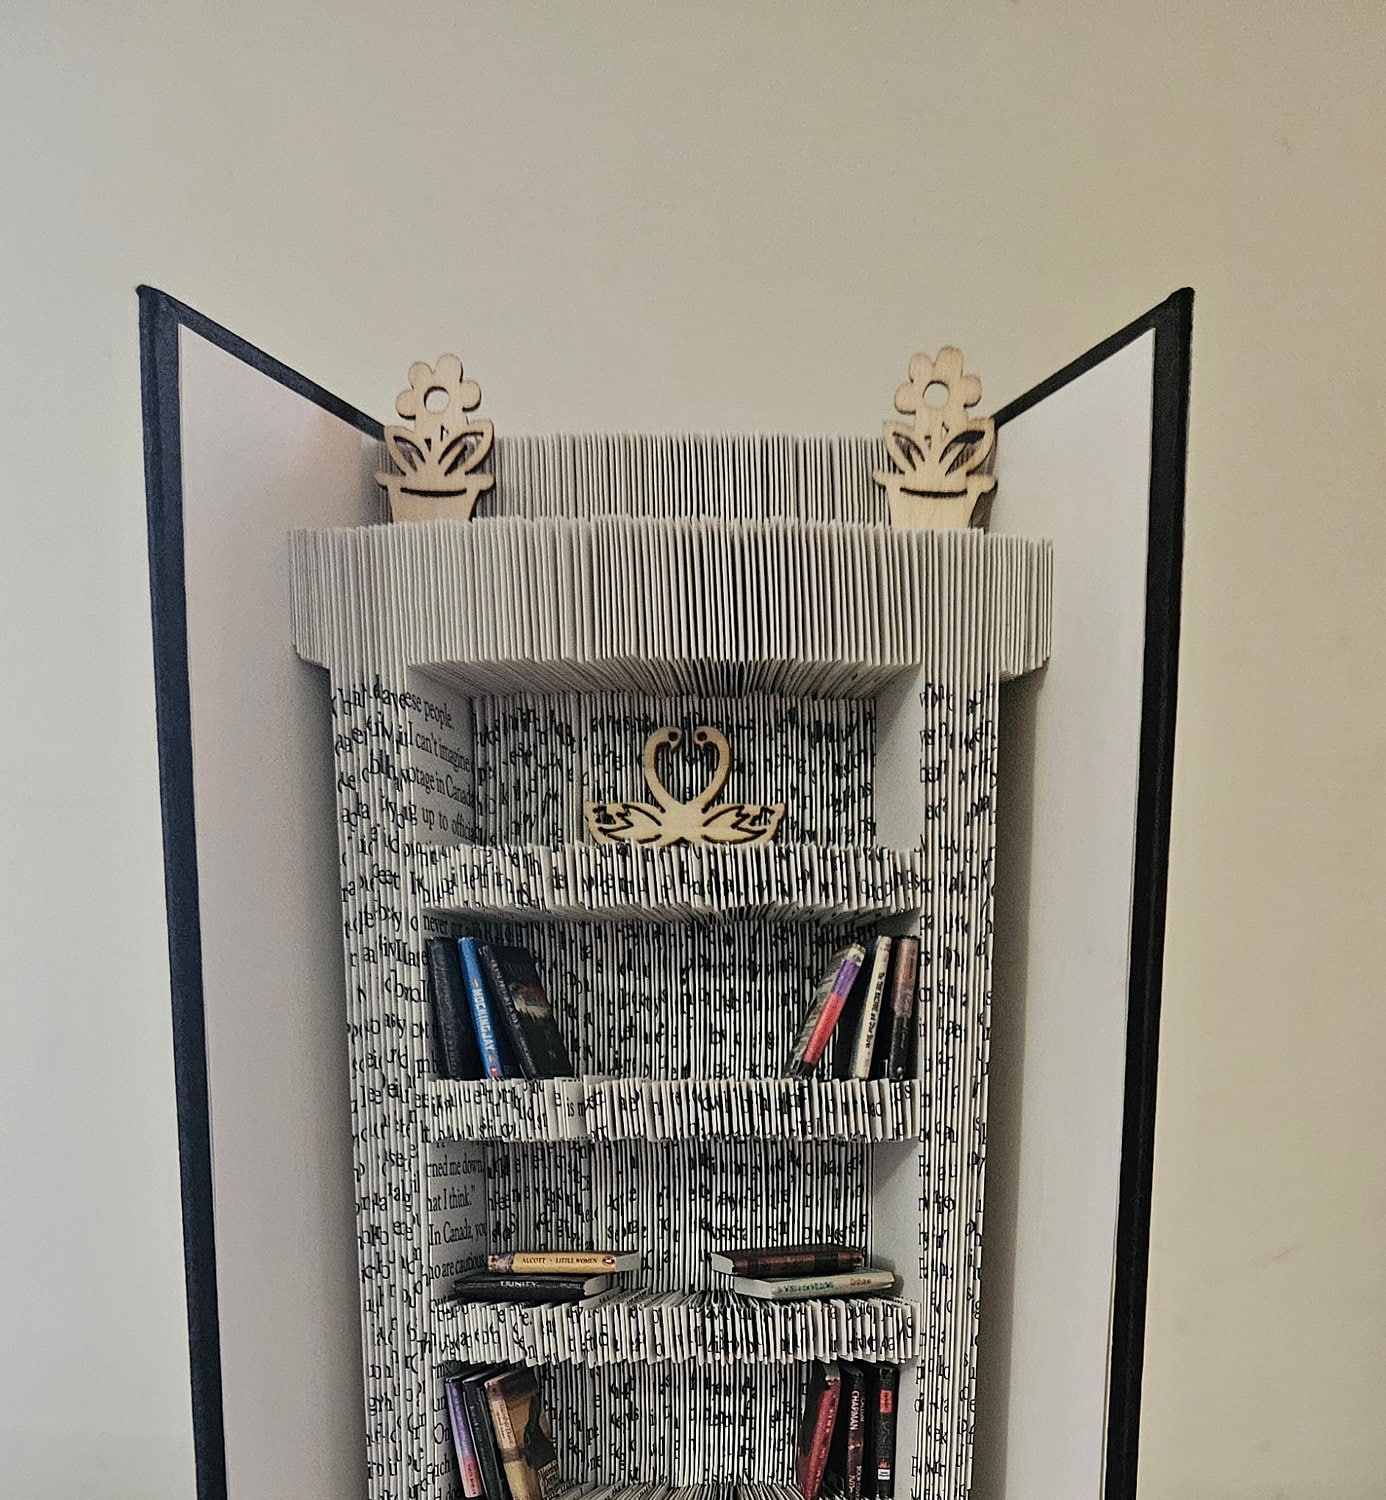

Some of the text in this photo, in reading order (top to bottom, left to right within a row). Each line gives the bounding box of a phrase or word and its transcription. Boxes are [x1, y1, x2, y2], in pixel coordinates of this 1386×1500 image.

[415, 732, 439, 757] can't
[438, 739, 471, 773] imagine
[421, 807, 435, 831] up
[438, 810, 449, 831] to
[423, 915, 448, 935] never
[471, 988, 497, 1051] MOCKINGJAY
[449, 1161, 461, 1175] me
[441, 1261, 454, 1277] are
[522, 1257, 546, 1265] ALCOTT
[849, 1390, 860, 1431] CHAPMAN
